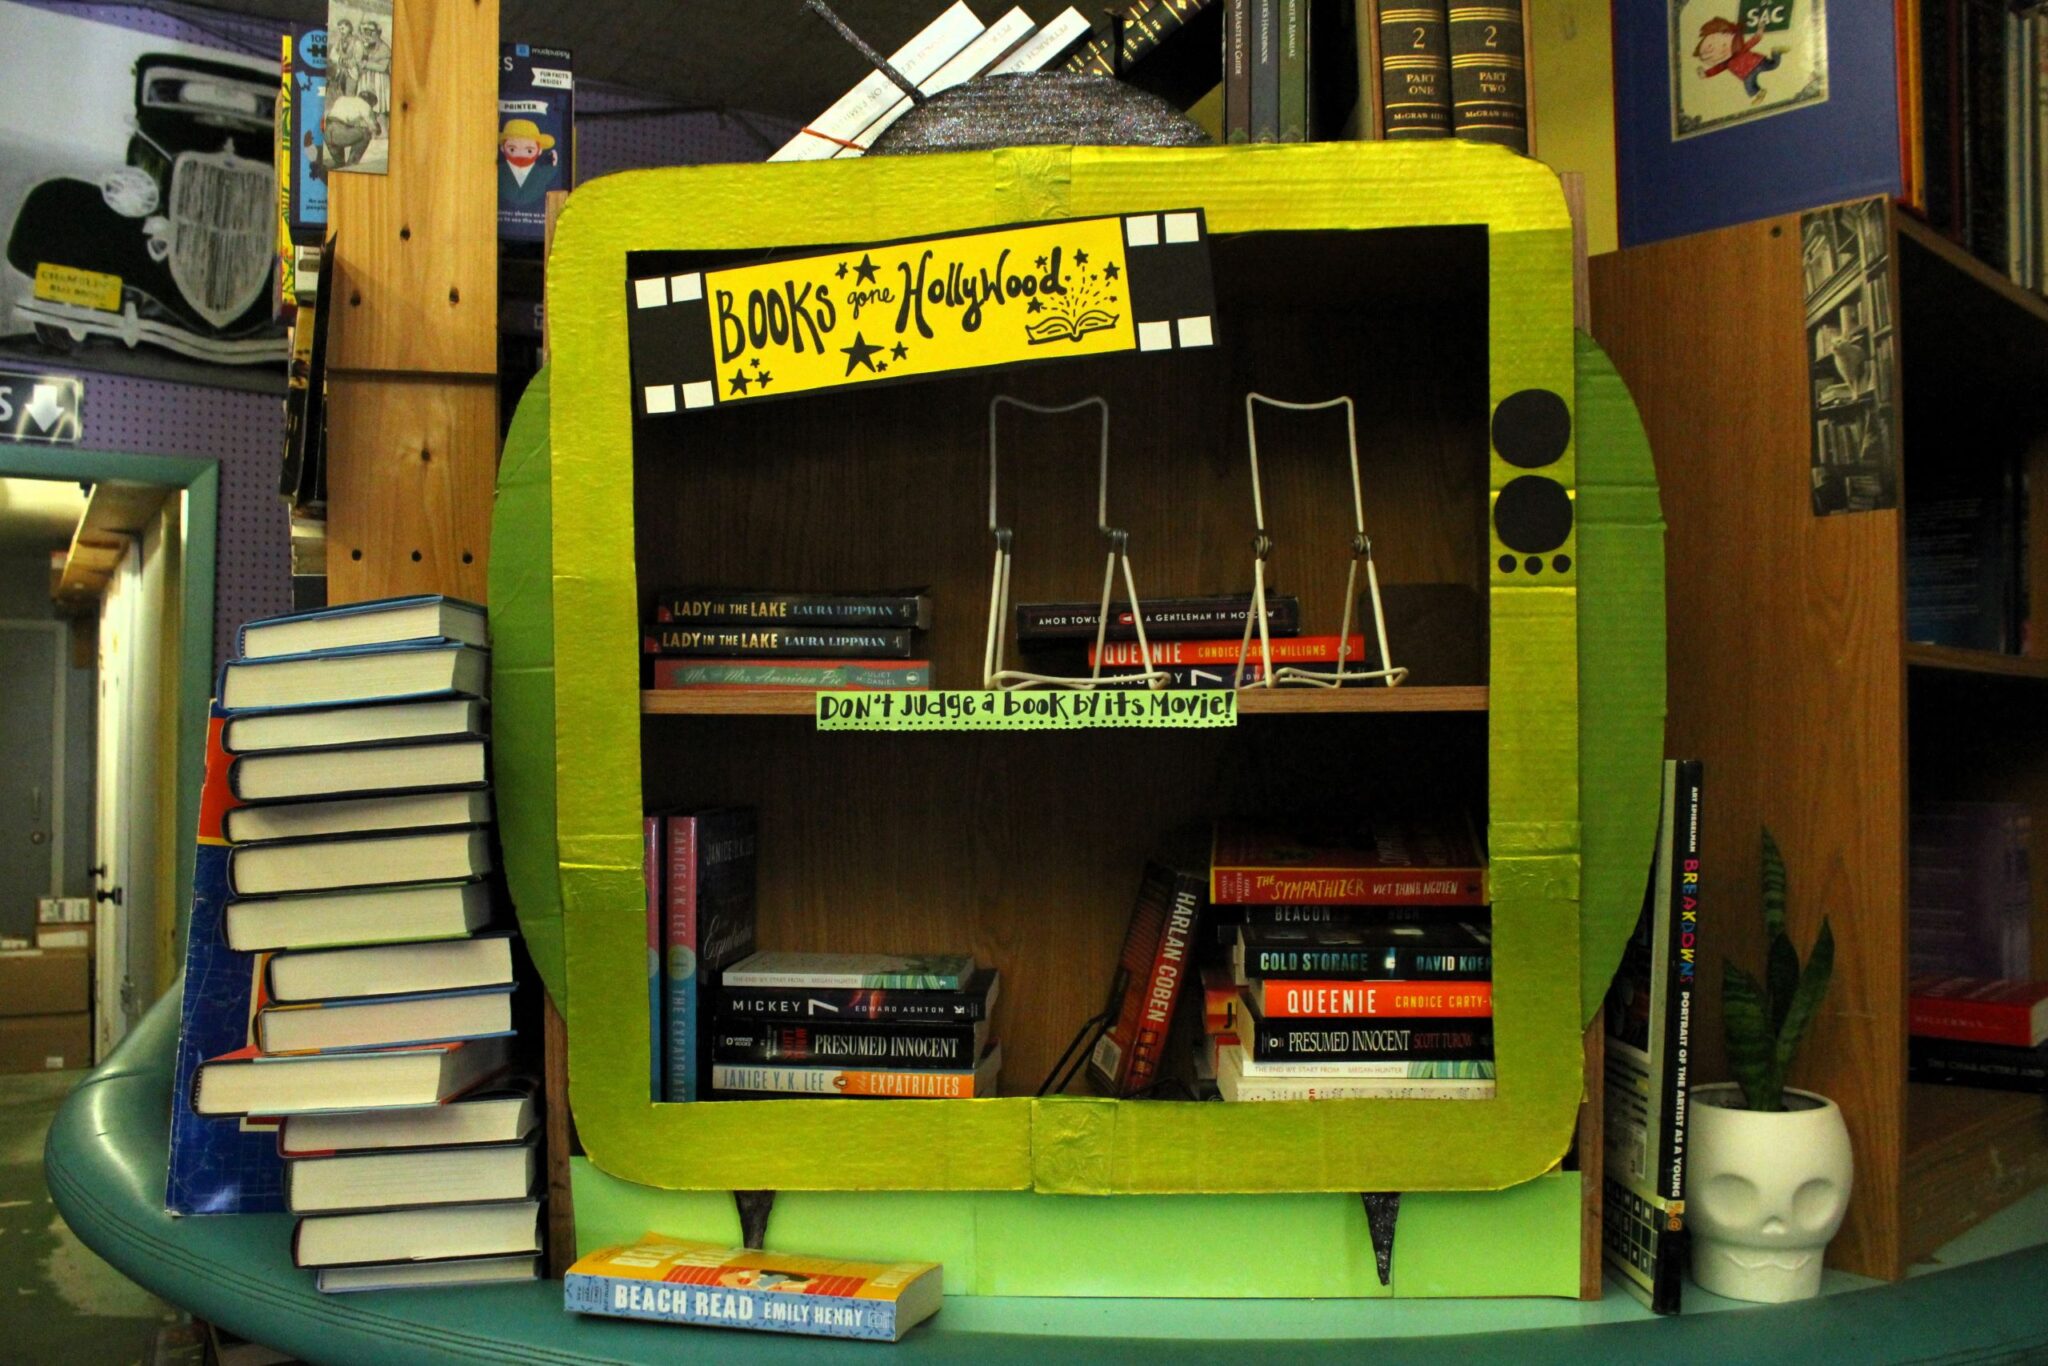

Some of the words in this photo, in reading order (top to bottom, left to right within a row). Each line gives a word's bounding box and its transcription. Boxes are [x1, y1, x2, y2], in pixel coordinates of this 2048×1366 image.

[1746, 6, 1784, 27] SAC
[1412, 26, 1426, 48] 2
[1484, 25, 1498, 48] 2
[1234, 51, 1242, 75] GUIDE
[1406, 74, 1436, 83] PART
[1479, 72, 1507, 82] PART
[1408, 86, 1436, 95] ONE
[1480, 84, 1506, 94] TWO
[716, 279, 836, 365] BOOKS
[846, 288, 896, 320] gone
[674, 601, 712, 617] LADY
[713, 604, 725, 614] IN
[730, 603, 748, 614] THE
[751, 602, 787, 618] LAKE
[794, 606, 832, 616] LAURA
[836, 606, 893, 616] LIPPMAN
[1156, 612, 1212, 622] GENTLEMAN
[1216, 612, 1227, 620] IN
[1038, 616, 1068, 626] AMOR
[1071, 616, 1107, 624] TOWL
[662, 632, 702, 648] LADY
[702, 634, 714, 646] IN
[720, 634, 738, 646] THE
[741, 632, 778, 648] LAKE
[784, 636, 824, 646] LAURA
[828, 636, 886, 647] LIPPMAN
[1104, 642, 1182, 665] QUENIE
[1198, 647, 1240, 658] CANDICE
[817, 670, 842, 686] Pie
[981, 693, 996, 715] a
[1003, 692, 1069, 721] book
[1104, 692, 1143, 717] its
[1149, 692, 1234, 719] Movie!
[1690, 804, 1698, 852] SPIEGELMAN
[673, 828, 686, 880] JANICE
[1256, 874, 1275, 888] THE
[1271, 878, 1366, 901] SYMPATHIZER
[1372, 884, 1392, 896] VIET
[1423, 881, 1458, 896] NGUYEN
[1274, 906, 1331, 922] BEACON
[1678, 858, 1700, 984] BREAKDOWNS
[673, 914, 686, 937] LEE
[1162, 890, 1197, 962] HARLAN
[1260, 952, 1298, 972] COLD
[1302, 952, 1369, 972] STORAGE
[1416, 955, 1455, 972] DAVID
[672, 989, 686, 1014] THE
[1146, 963, 1178, 1024] COBEN
[1287, 990, 1376, 1014] QUEENIE
[1395, 996, 1443, 1008] CANDICE
[733, 1000, 800, 1012] MICKEY
[855, 1005, 897, 1014] EDWARD
[903, 1006, 944, 1014] ASHTON
[1680, 991, 1690, 1046] PORTRAIT
[814, 1036, 887, 1056] PRESUMED
[890, 1036, 959, 1058] INNOCENT
[1289, 1031, 1350, 1052] PRESUMED
[1352, 1030, 1411, 1051] INNOCENT
[1414, 1034, 1438, 1048] SCOTT
[1678, 1048, 1688, 1064] OF
[724, 1069, 768, 1088] JANICE
[772, 1071, 785, 1090] Y.
[788, 1072, 802, 1090] K.
[804, 1074, 825, 1092] LEE
[870, 1074, 960, 1097] EXPATRIATES
[1677, 1066, 1686, 1088] THE
[1676, 1089, 1686, 1127] ARTIST
[1675, 1128, 1684, 1142] AS
[1674, 1145, 1682, 1154] A
[1672, 1157, 1682, 1198] YOUNG
[614, 1284, 688, 1316] BEACH
[696, 1290, 754, 1321] READ
[764, 1300, 809, 1324] EMILY
[814, 1306, 863, 1328] HENRY
